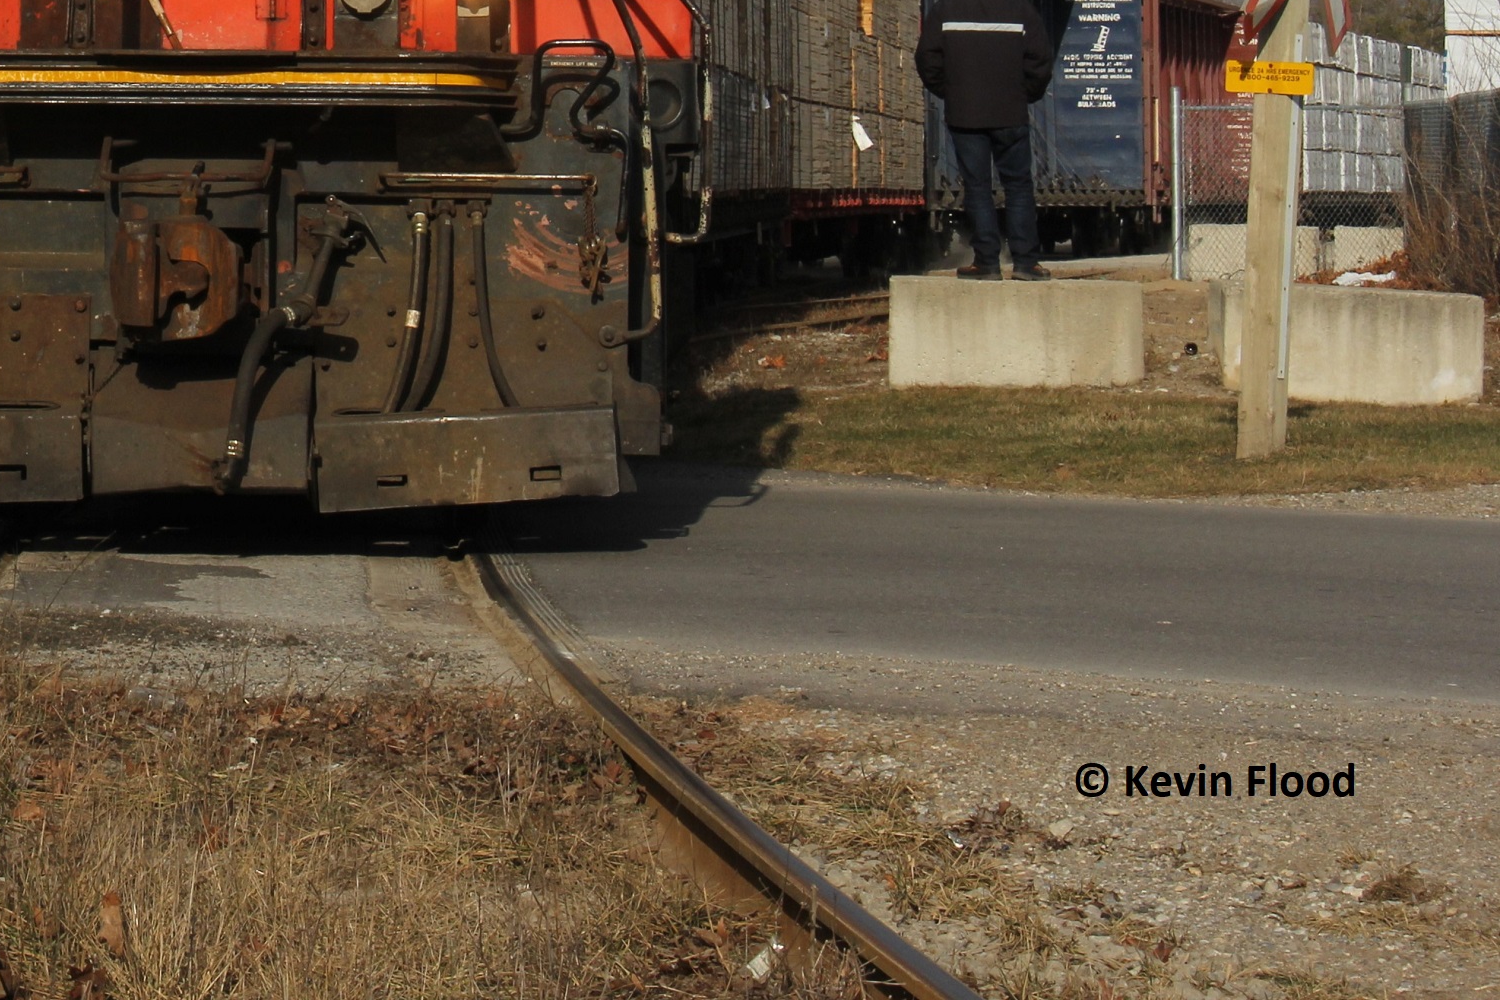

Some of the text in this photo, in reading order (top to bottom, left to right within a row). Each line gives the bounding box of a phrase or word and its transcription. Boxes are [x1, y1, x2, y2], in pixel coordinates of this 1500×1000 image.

[1078, 13, 1121, 21] WARNING
[1228, 66, 1254, 74] URGE
[1277, 68, 1310, 76] EMERGENCY
[1240, 73, 1300, 82] 800-465-9239
